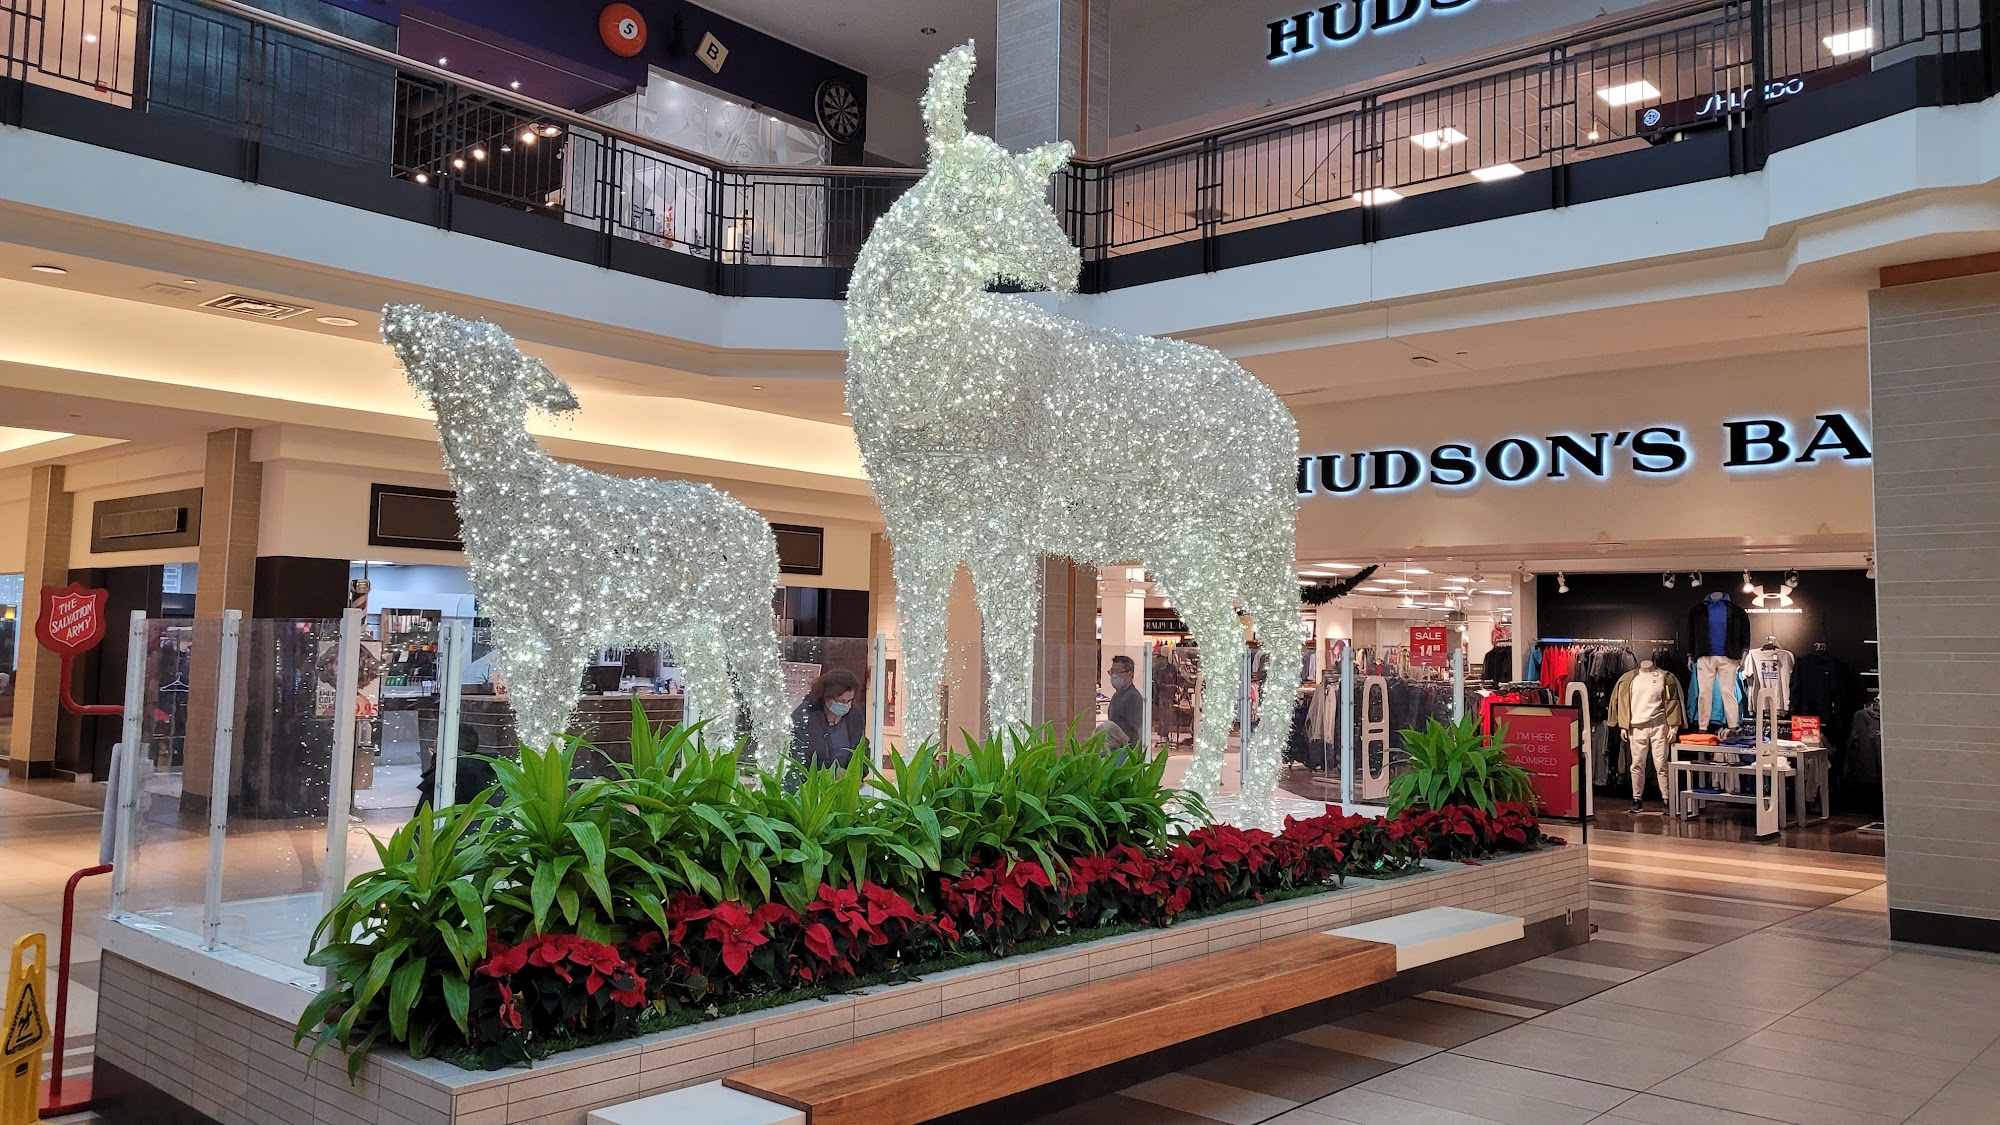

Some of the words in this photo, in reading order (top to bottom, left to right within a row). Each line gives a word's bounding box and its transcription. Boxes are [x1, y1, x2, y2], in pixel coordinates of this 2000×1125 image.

[623, 22, 634, 34] 5
[1266, 0, 1476, 60] HUD
[706, 42, 719, 60] B
[1722, 413, 1872, 467] BA
[59, 598, 77, 615] THE
[51, 601, 93, 633] SALVATION
[66, 616, 92, 640] ARMY
[1415, 632, 1442, 640] SALE
[1517, 732, 1530, 740] I'M
[1531, 732, 1557, 742] HERE
[1522, 743, 1536, 753] TO
[1537, 744, 1550, 753] BE
[1515, 755, 1558, 766] ADMIRED
